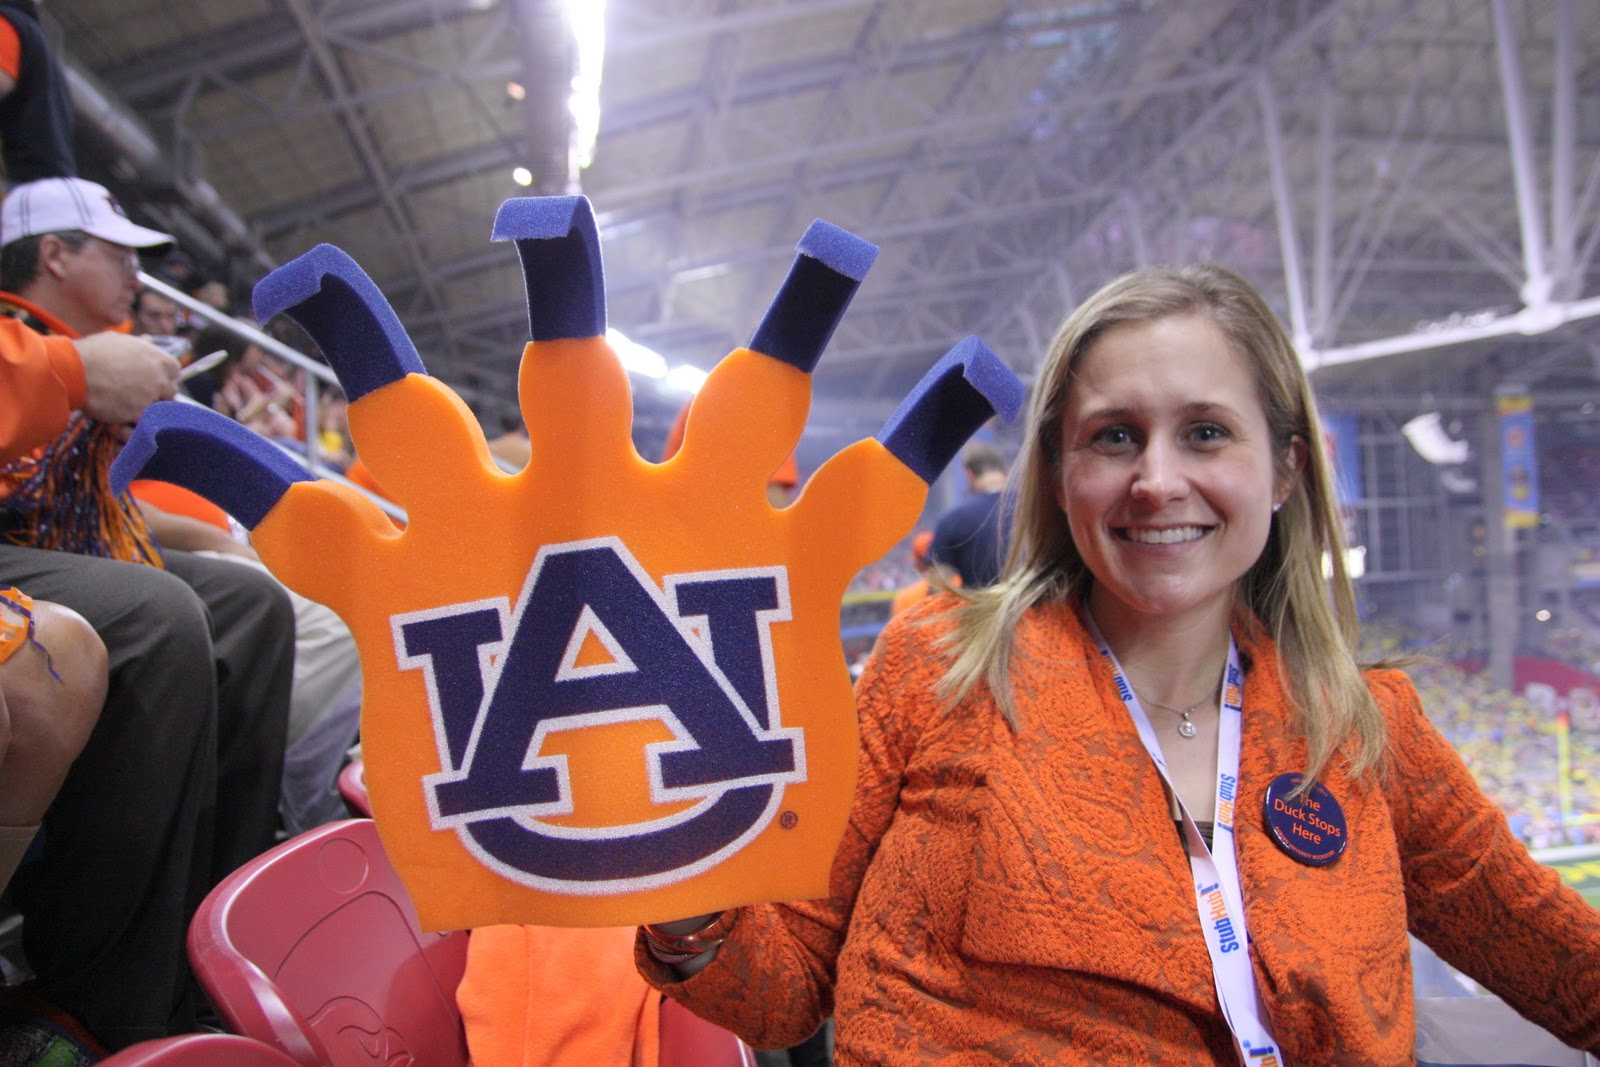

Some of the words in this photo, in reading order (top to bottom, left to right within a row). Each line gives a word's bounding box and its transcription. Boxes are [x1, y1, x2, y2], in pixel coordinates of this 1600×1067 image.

[1274, 798, 1306, 821] Duck
[1308, 813, 1342, 837] Stops
[1292, 822, 1322, 845] Here
